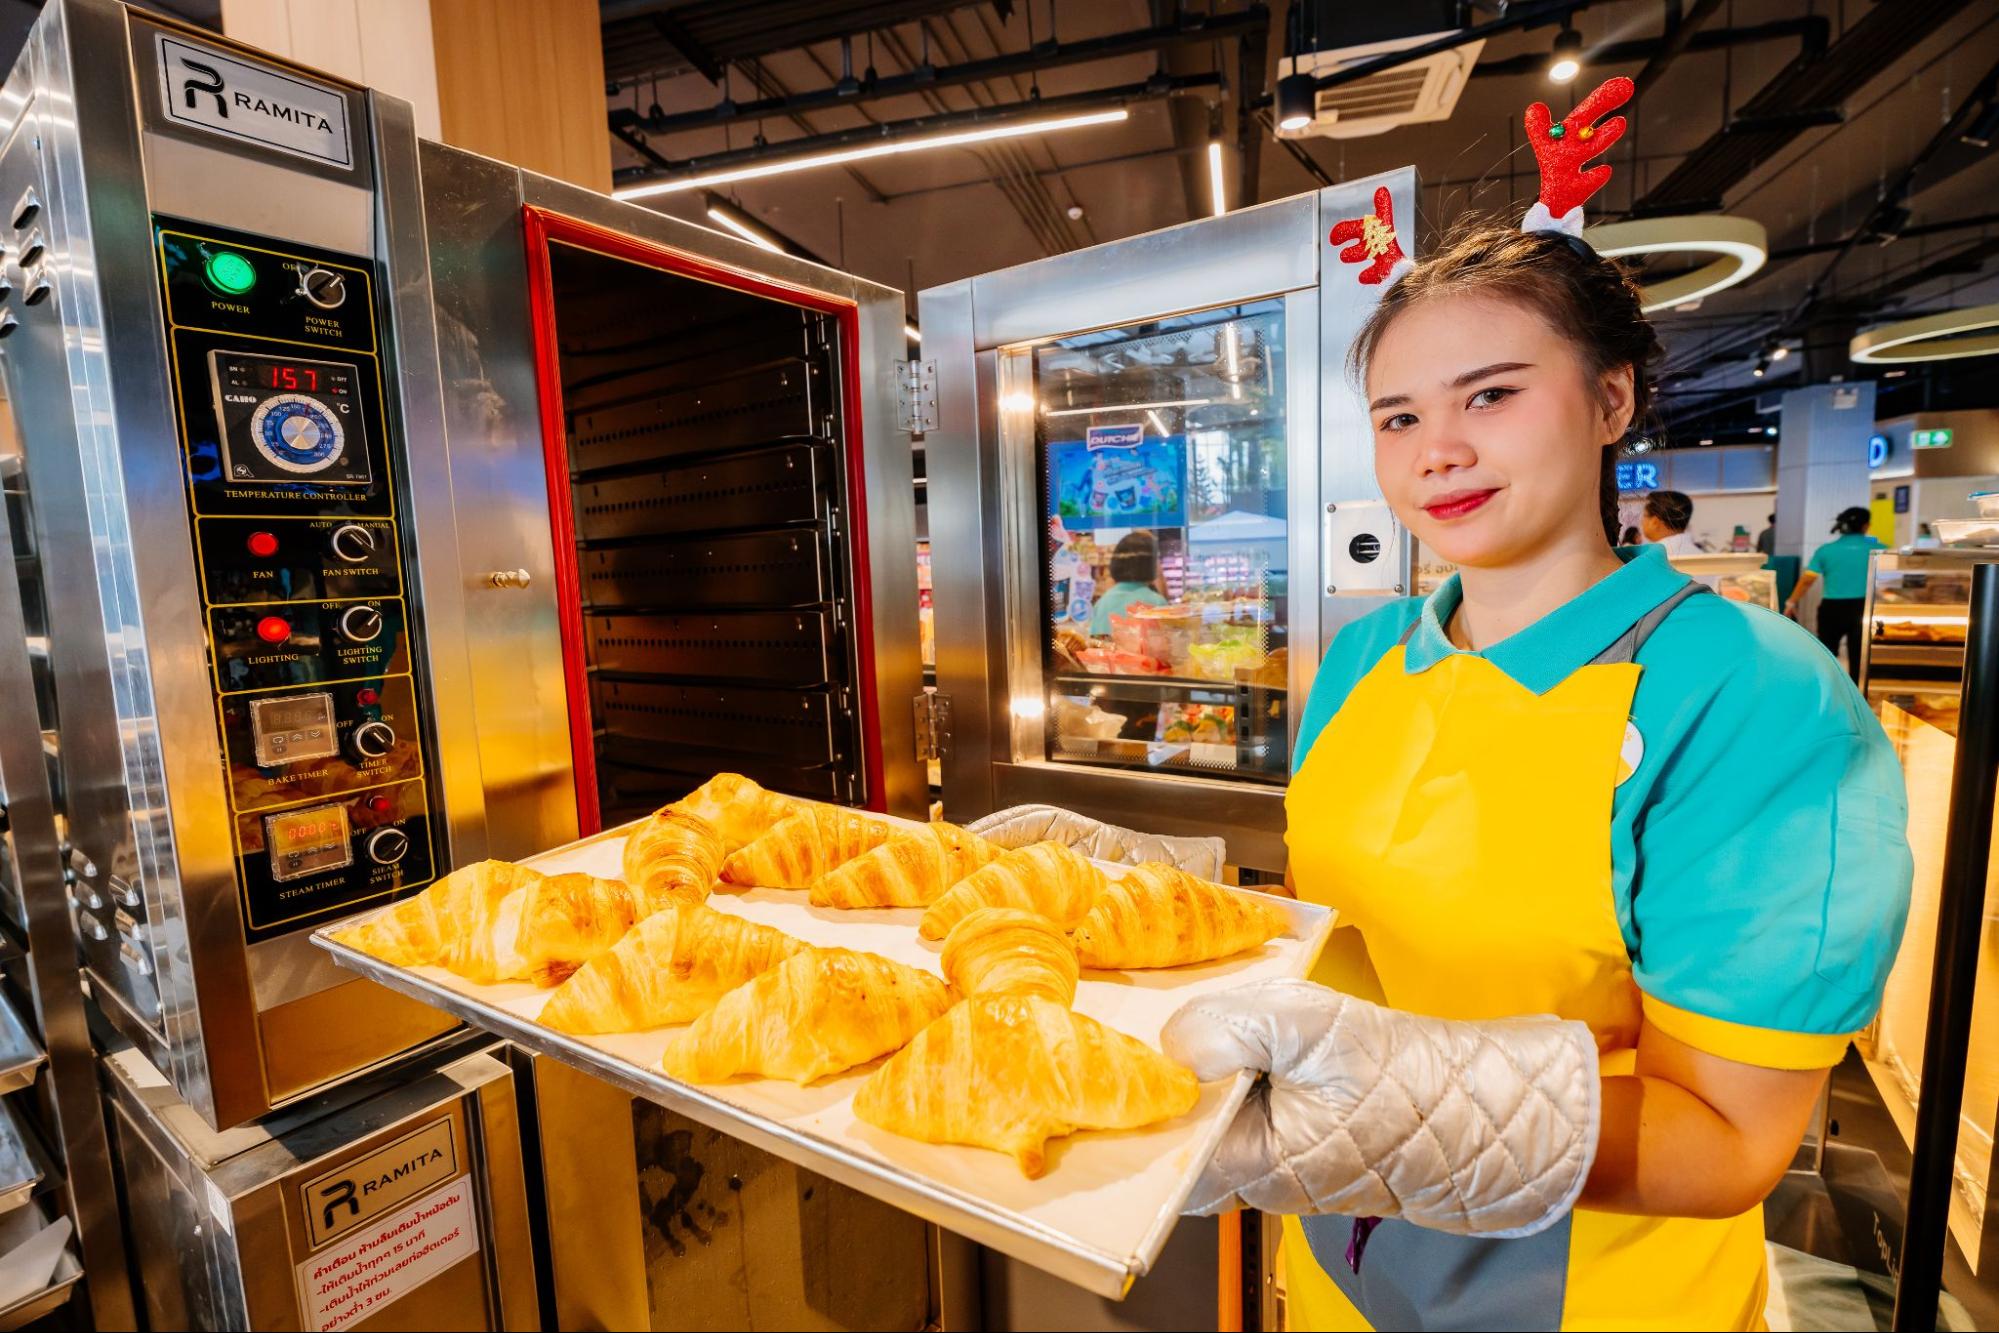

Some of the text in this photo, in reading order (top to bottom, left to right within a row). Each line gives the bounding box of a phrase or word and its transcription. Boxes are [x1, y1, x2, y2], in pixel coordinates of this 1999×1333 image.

[234, 91, 333, 134] RAMITA
[211, 301, 251, 314] POWER
[305, 316, 340, 328] POWER
[304, 325, 343, 338] SWITCH
[272, 367, 318, 392] 157
[224, 489, 367, 501] TEMPERATURE CONTROLLER
[253, 570, 274, 579] FAN
[323, 568, 379, 577] FAN SWITCH
[367, 600, 381, 608] ON
[337, 646, 383, 657] LIGHTING
[248, 653, 299, 665] LIGHTING
[343, 654, 379, 665] SWITCH
[336, 719, 354, 728] OFF
[381, 713, 395, 722] ON
[359, 758, 388, 770] TIMER
[268, 769, 329, 786] BAKE TIMER
[357, 765, 392, 778] SWITCH
[393, 818, 407, 827] ON
[372, 862, 401, 876] STEAM
[370, 870, 404, 885] SWITCH
[279, 876, 347, 900] STEAM TIMER
[362, 1148, 443, 1196] RAMITA
[393, 1243, 404, 1254] 15
[366, 1297, 373, 1307] 3
